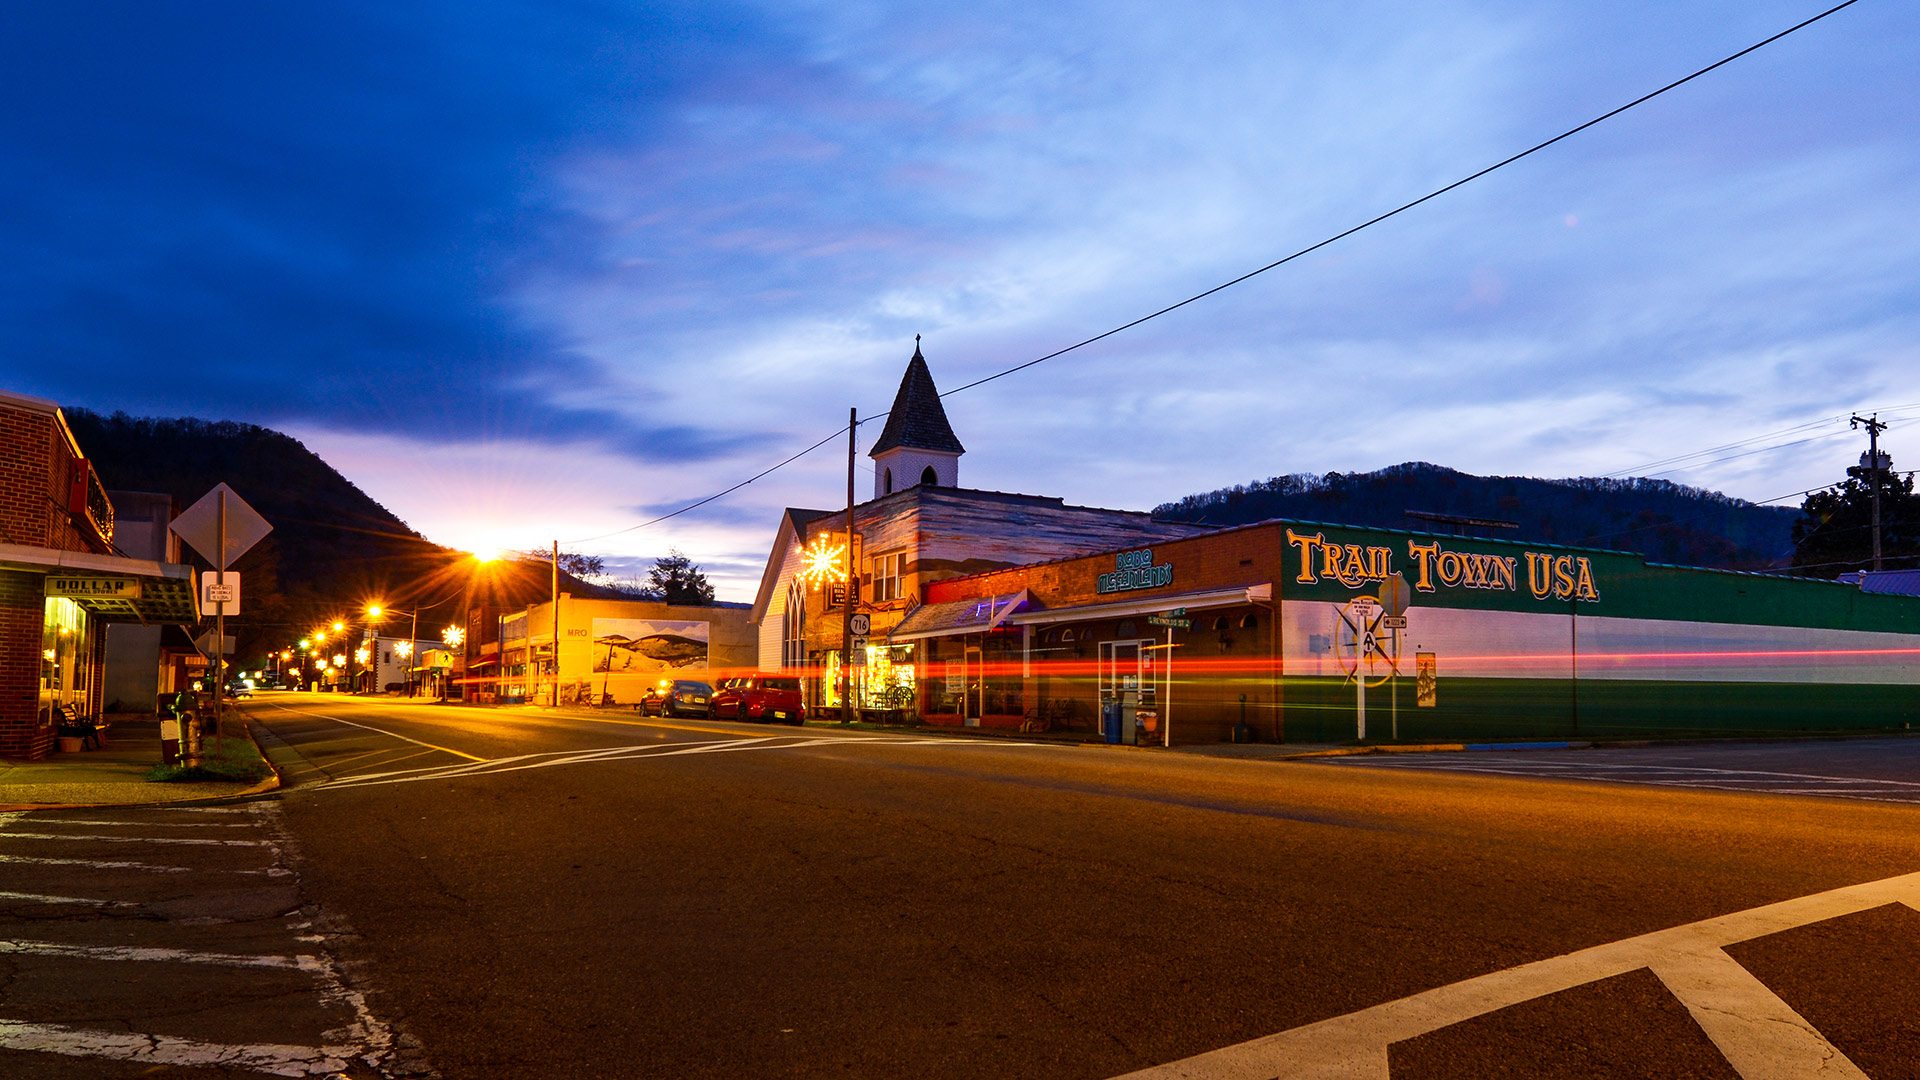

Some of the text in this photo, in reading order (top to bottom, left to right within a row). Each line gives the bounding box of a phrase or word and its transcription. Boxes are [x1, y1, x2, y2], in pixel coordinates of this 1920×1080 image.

[1116, 549, 1153, 571] BOBO
[1409, 540, 1517, 592] TOWN
[1523, 551, 1600, 602] USA
[56, 580, 124, 590] DOLLAR
[853, 619, 867, 631] 716
[567, 628, 588, 637] MRO
